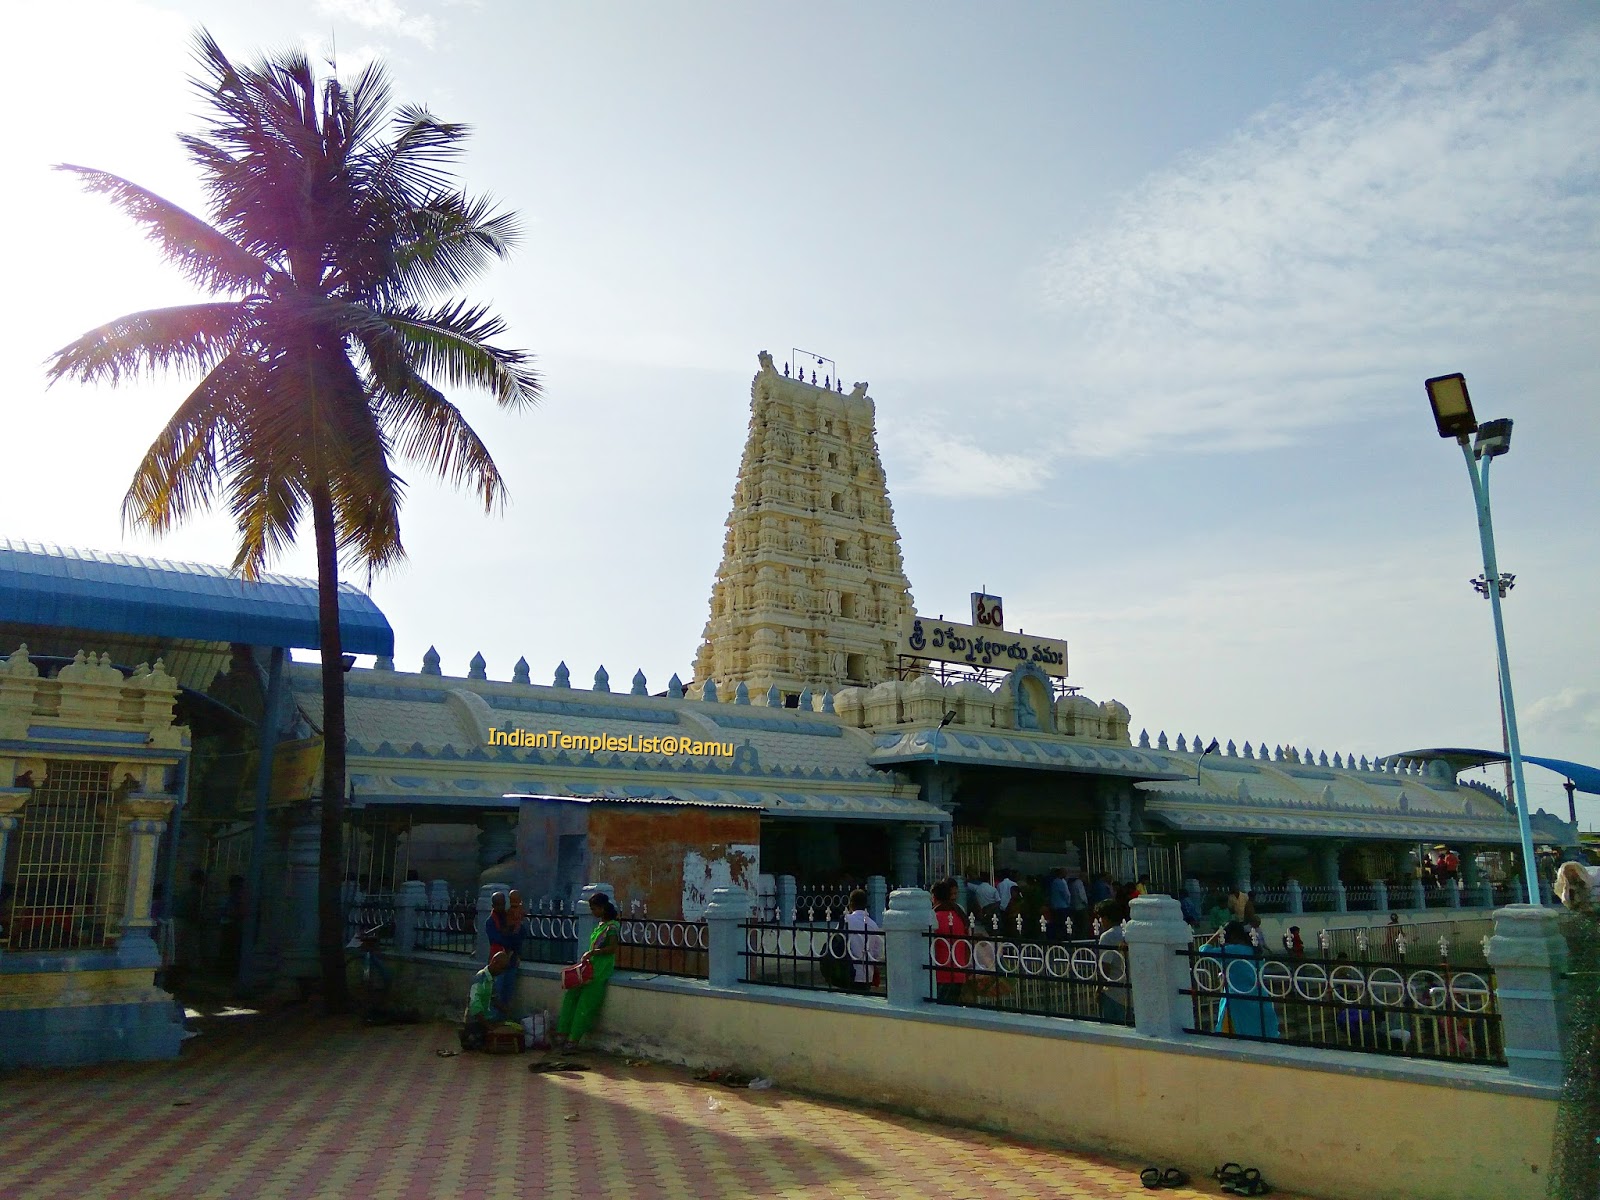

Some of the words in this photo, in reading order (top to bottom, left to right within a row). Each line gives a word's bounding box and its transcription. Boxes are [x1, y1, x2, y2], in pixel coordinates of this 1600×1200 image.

[977, 596, 1003, 627] ఓం
[909, 620, 926, 651] శ్రీ
[1032, 644, 1063, 665] నమః
